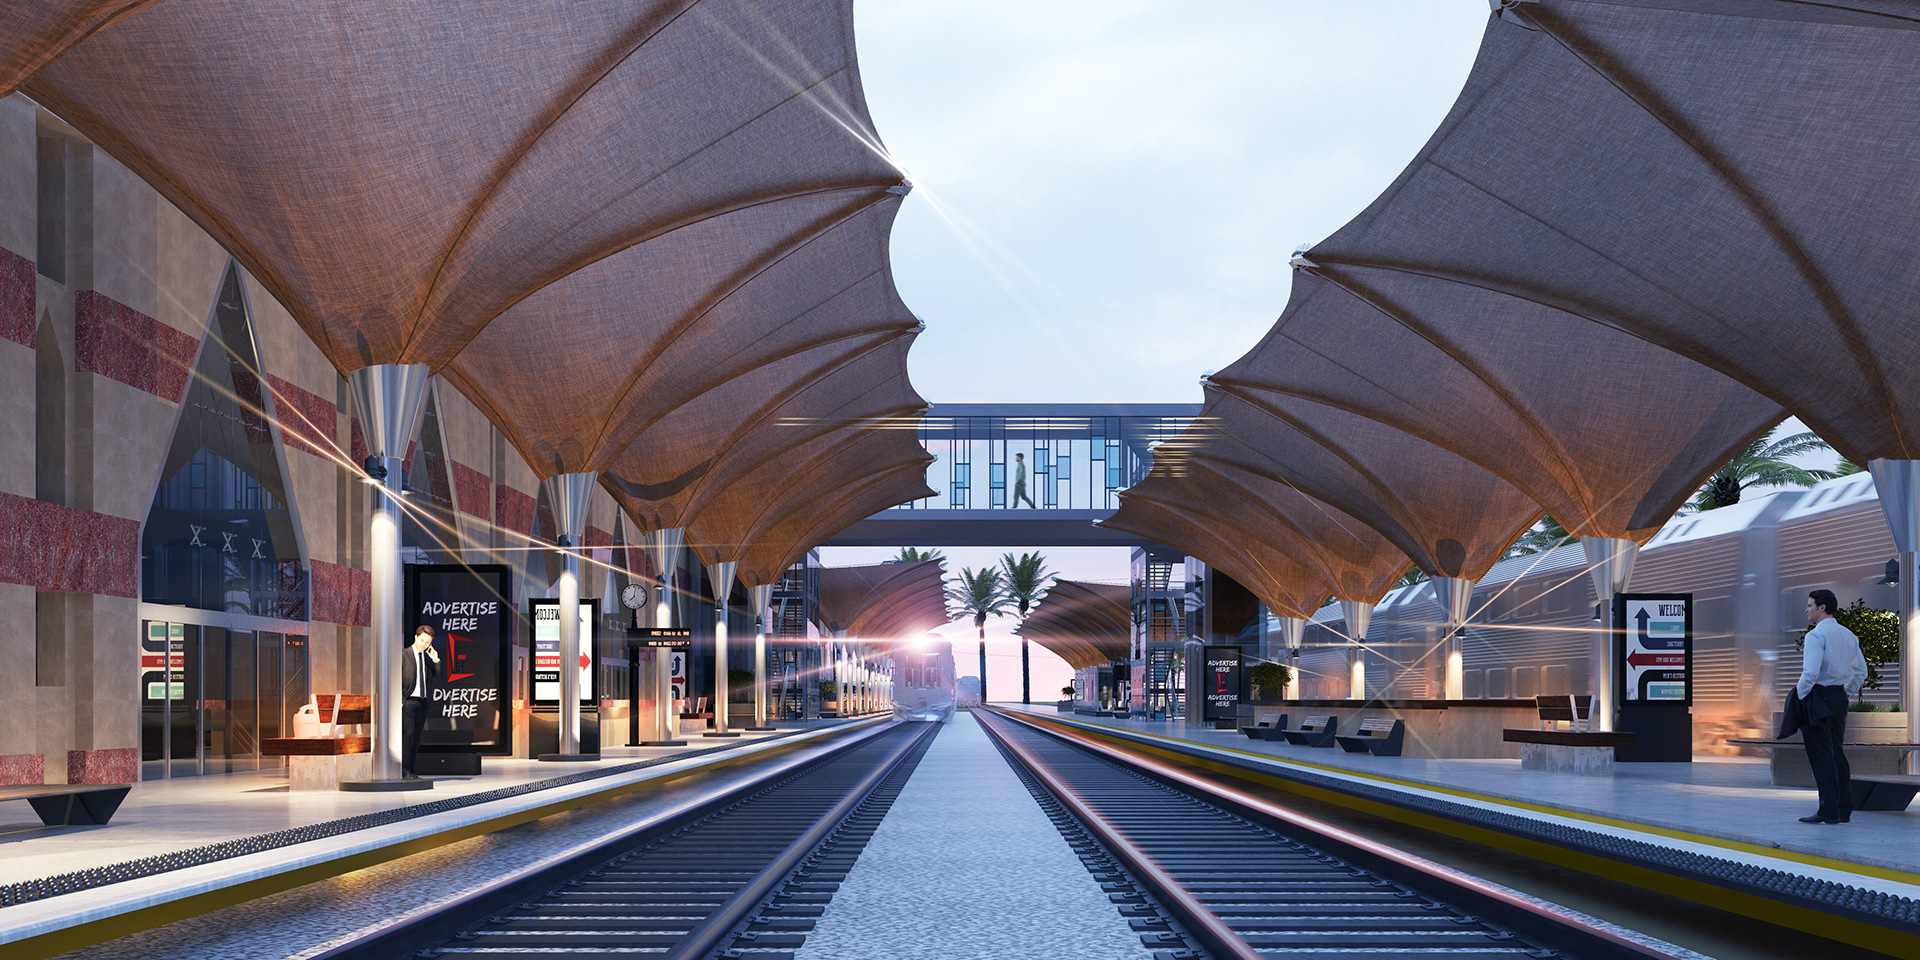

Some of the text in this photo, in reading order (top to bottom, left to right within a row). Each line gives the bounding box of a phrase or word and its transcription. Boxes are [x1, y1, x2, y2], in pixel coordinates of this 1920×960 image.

[422, 601, 498, 616] ADVERTISE
[442, 618, 478, 632] HERE
[432, 688, 498, 703] DVERTISE
[442, 704, 478, 719] HERE
